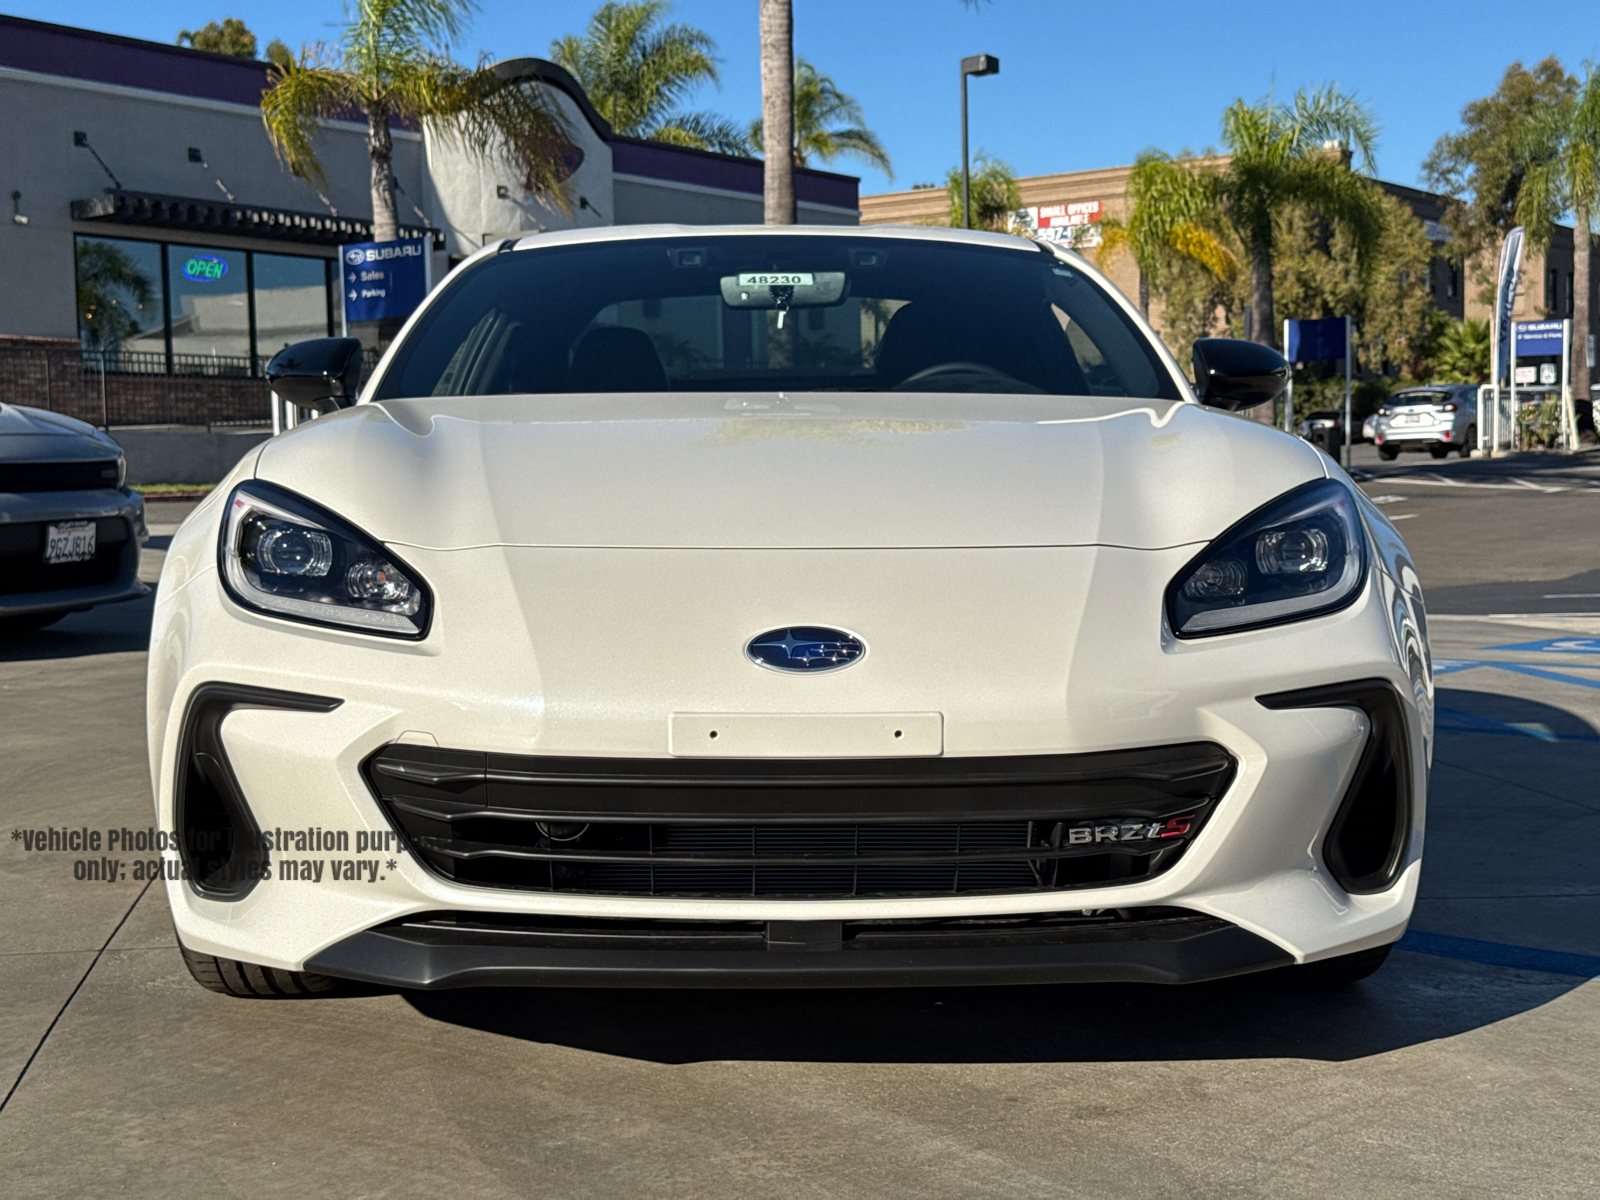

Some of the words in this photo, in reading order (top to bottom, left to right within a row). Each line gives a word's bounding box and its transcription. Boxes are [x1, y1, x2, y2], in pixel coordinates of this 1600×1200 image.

[1068, 201, 1099, 215] OFFICES
[365, 244, 423, 262] SUBARU
[185, 258, 223, 279] OPEN
[360, 270, 385, 282] Sales
[747, 276, 802, 284] 48230
[361, 288, 386, 299] Parking
[1527, 322, 1562, 332] SUBARU
[1068, 823, 1144, 844] BRZ
